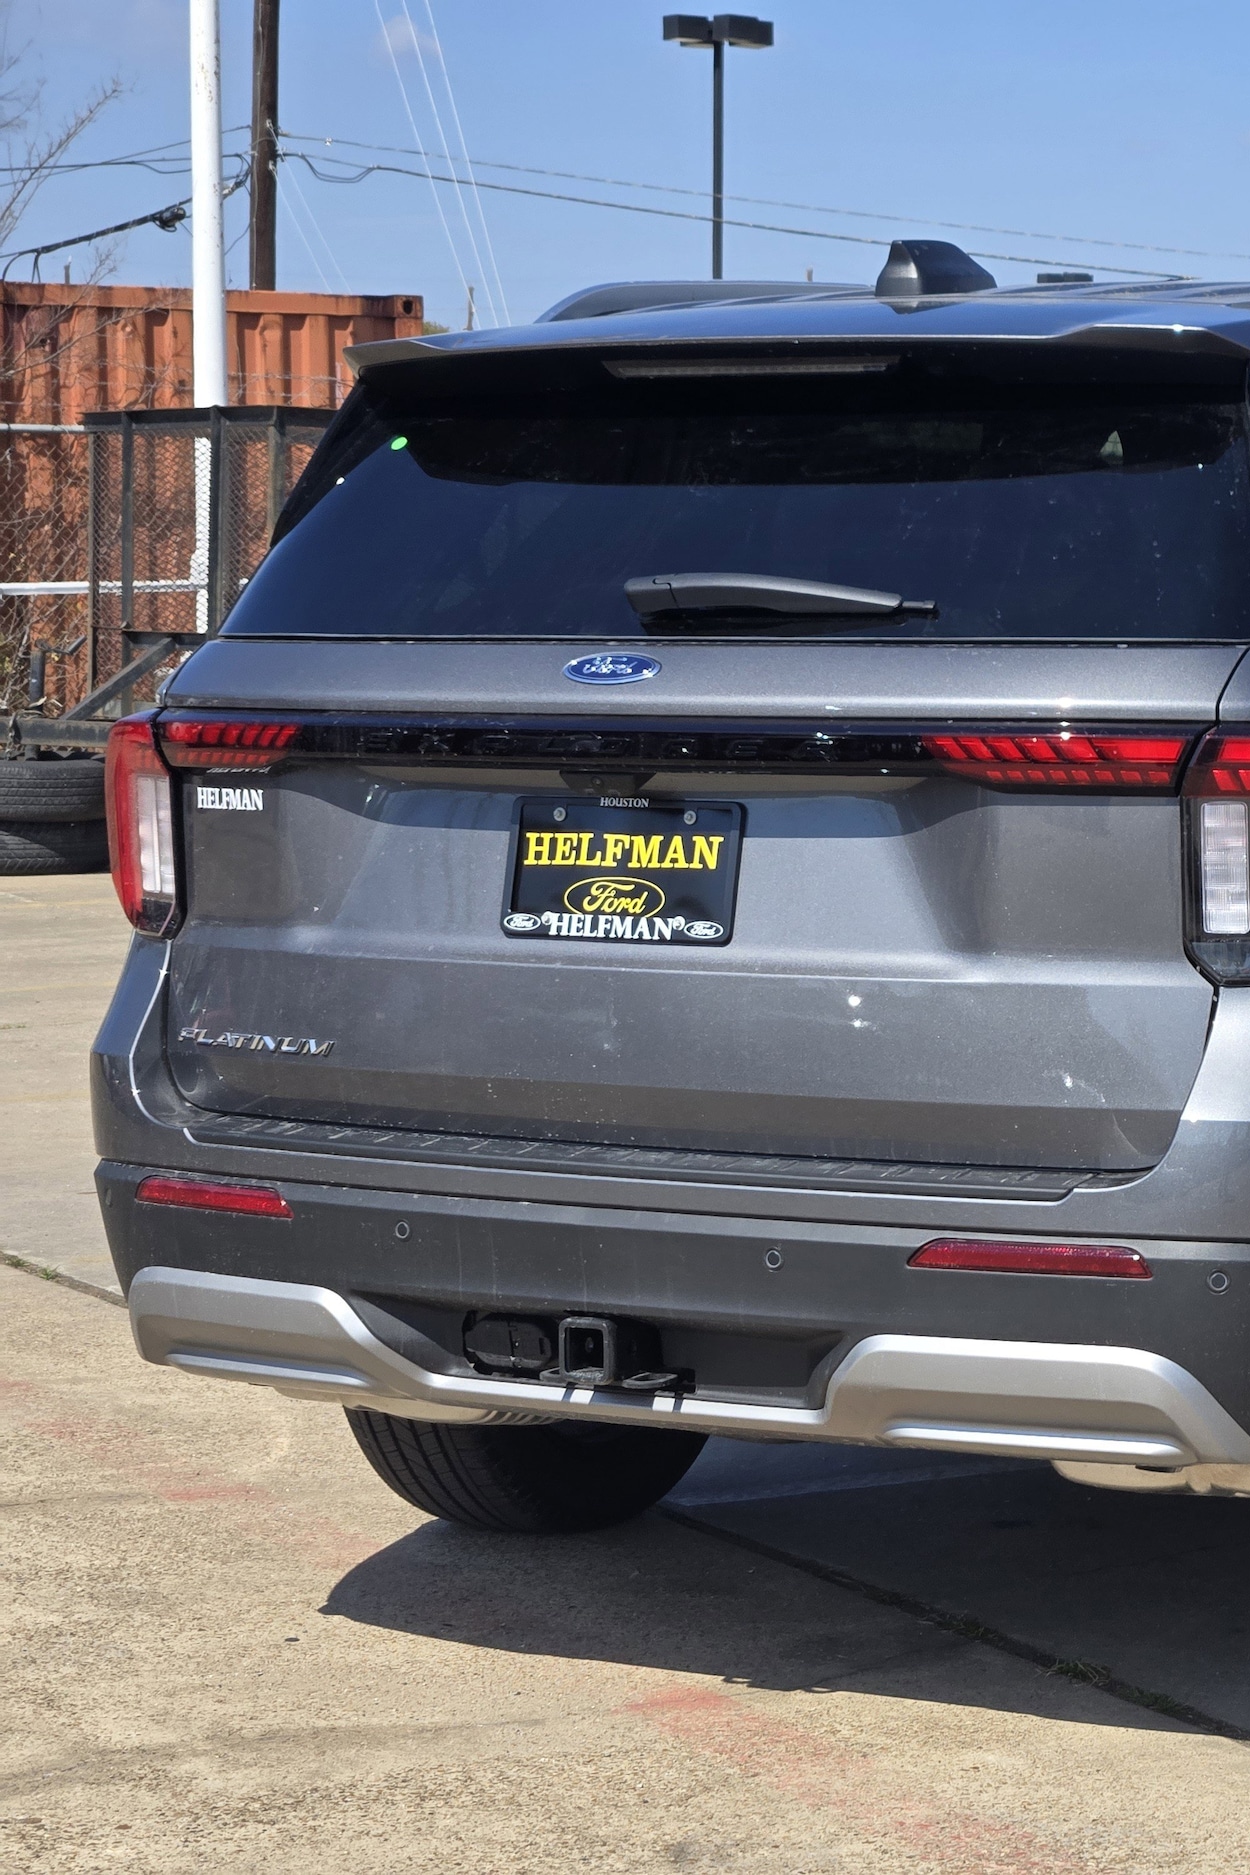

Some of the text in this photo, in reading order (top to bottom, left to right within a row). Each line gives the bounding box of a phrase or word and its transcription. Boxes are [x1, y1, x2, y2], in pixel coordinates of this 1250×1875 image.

[582, 657, 638, 675] Ford
[197, 787, 264, 811] HELFMAN
[600, 797, 650, 809] HOUSTON
[524, 832, 725, 870] HELFMAN
[582, 881, 650, 915] Ford
[510, 911, 717, 941] Ford HELFMAN Ford
[177, 1027, 336, 1057] PLATINUM
